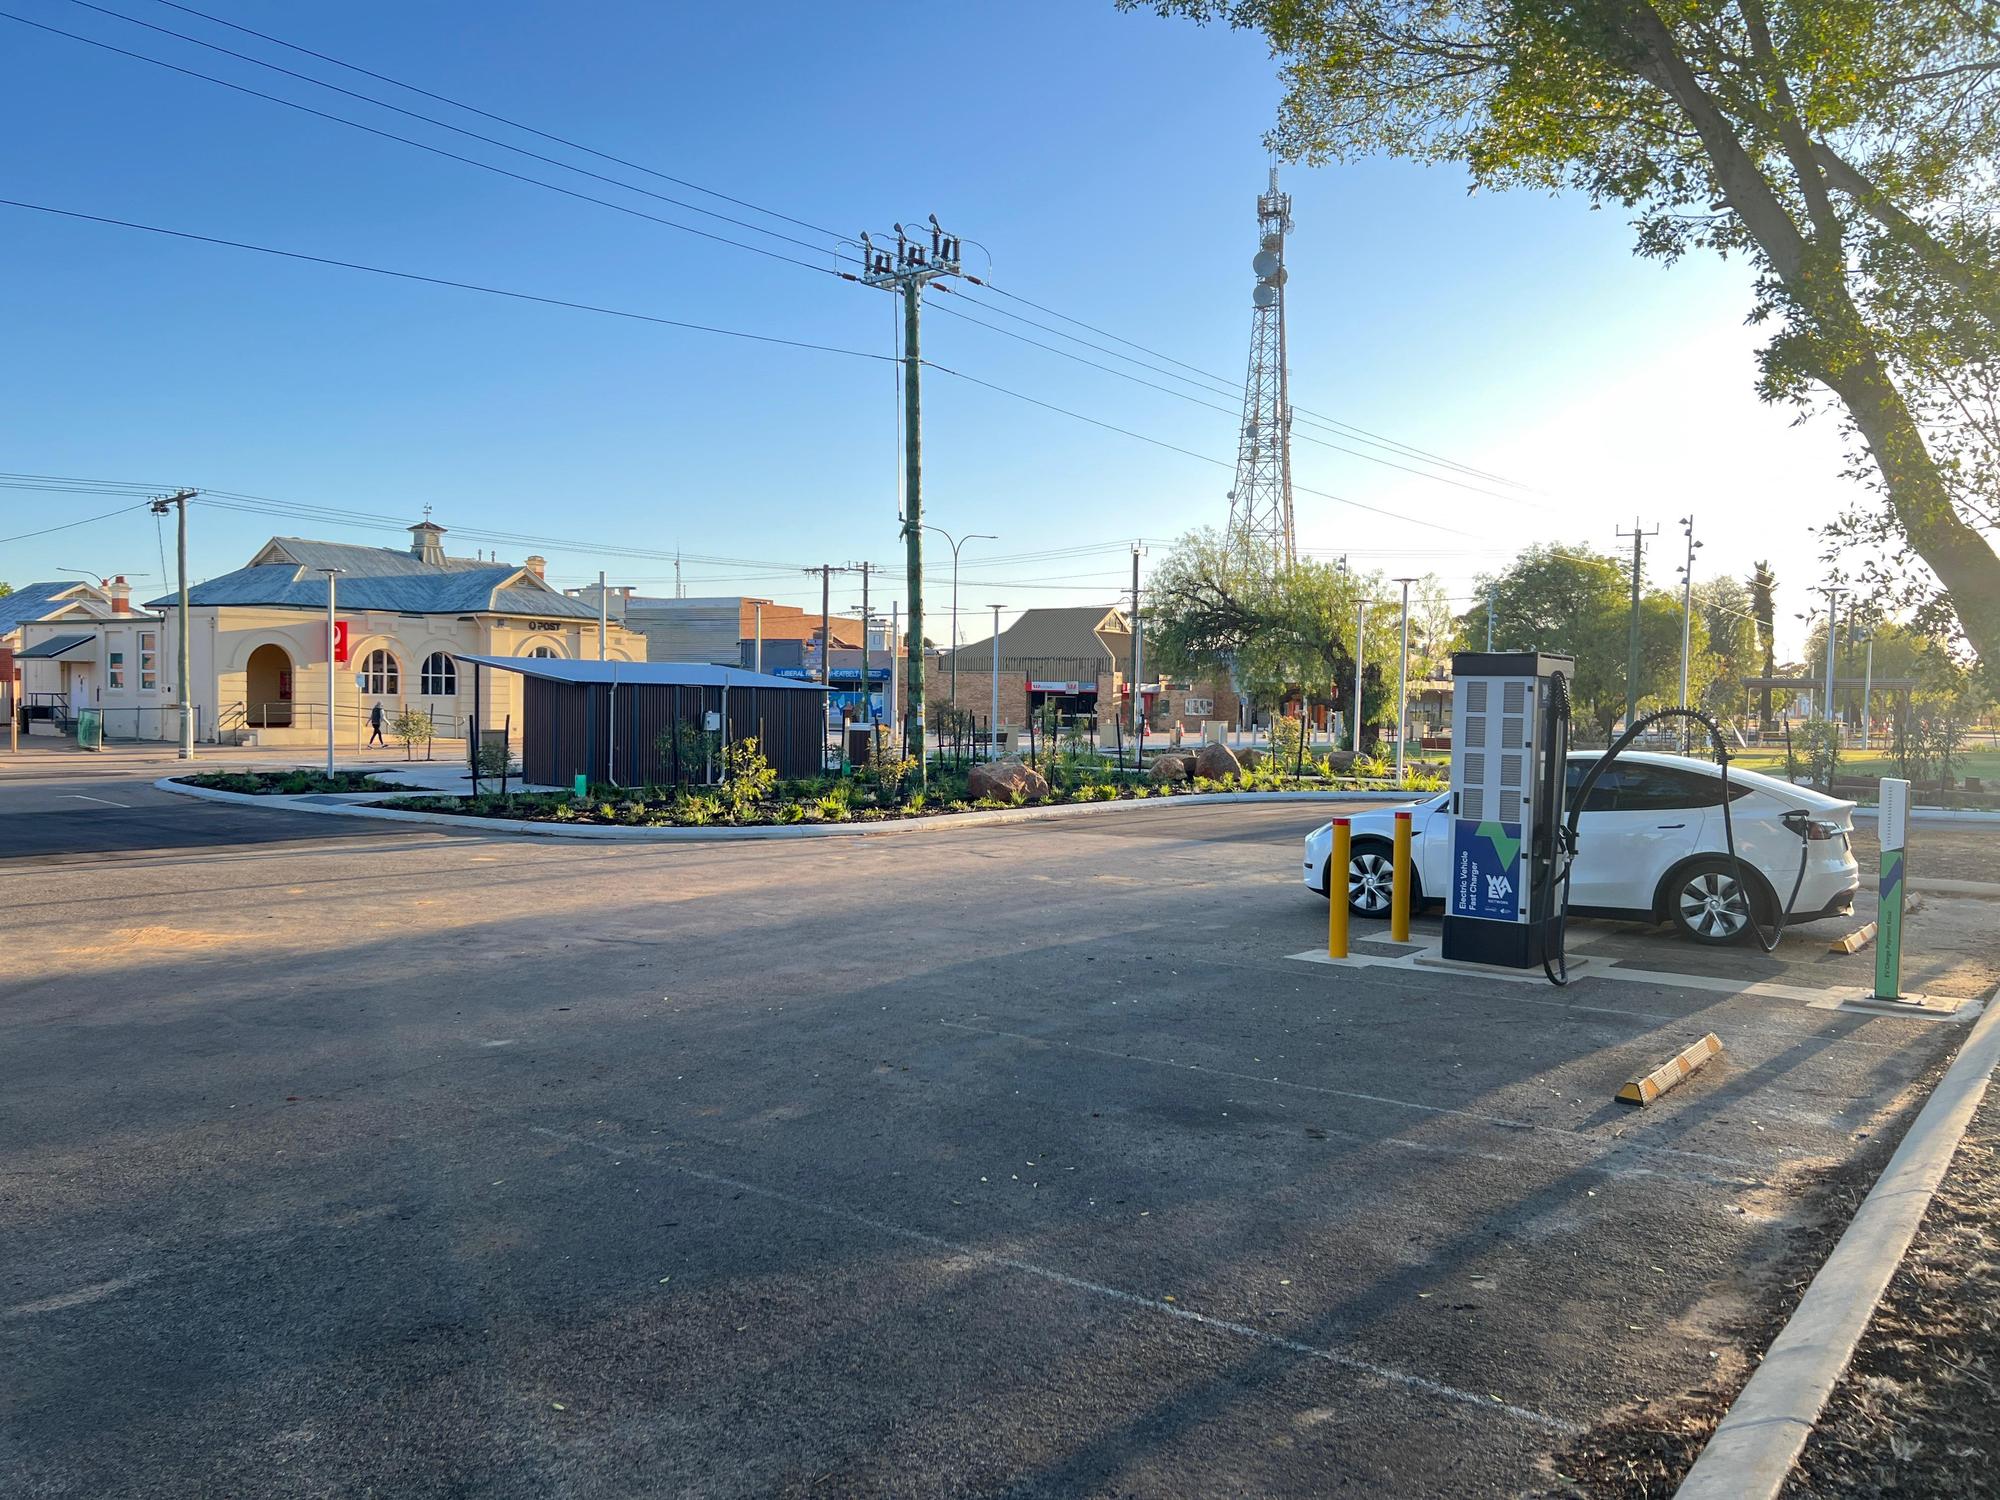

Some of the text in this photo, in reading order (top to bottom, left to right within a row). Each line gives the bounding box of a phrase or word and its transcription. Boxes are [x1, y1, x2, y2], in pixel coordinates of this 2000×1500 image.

[537, 622, 561, 631] POST
[781, 669, 804, 677] LIBERAL
[1459, 850, 1468, 910] Electric Vehicle
[1468, 862, 1479, 911] Fast Charger
